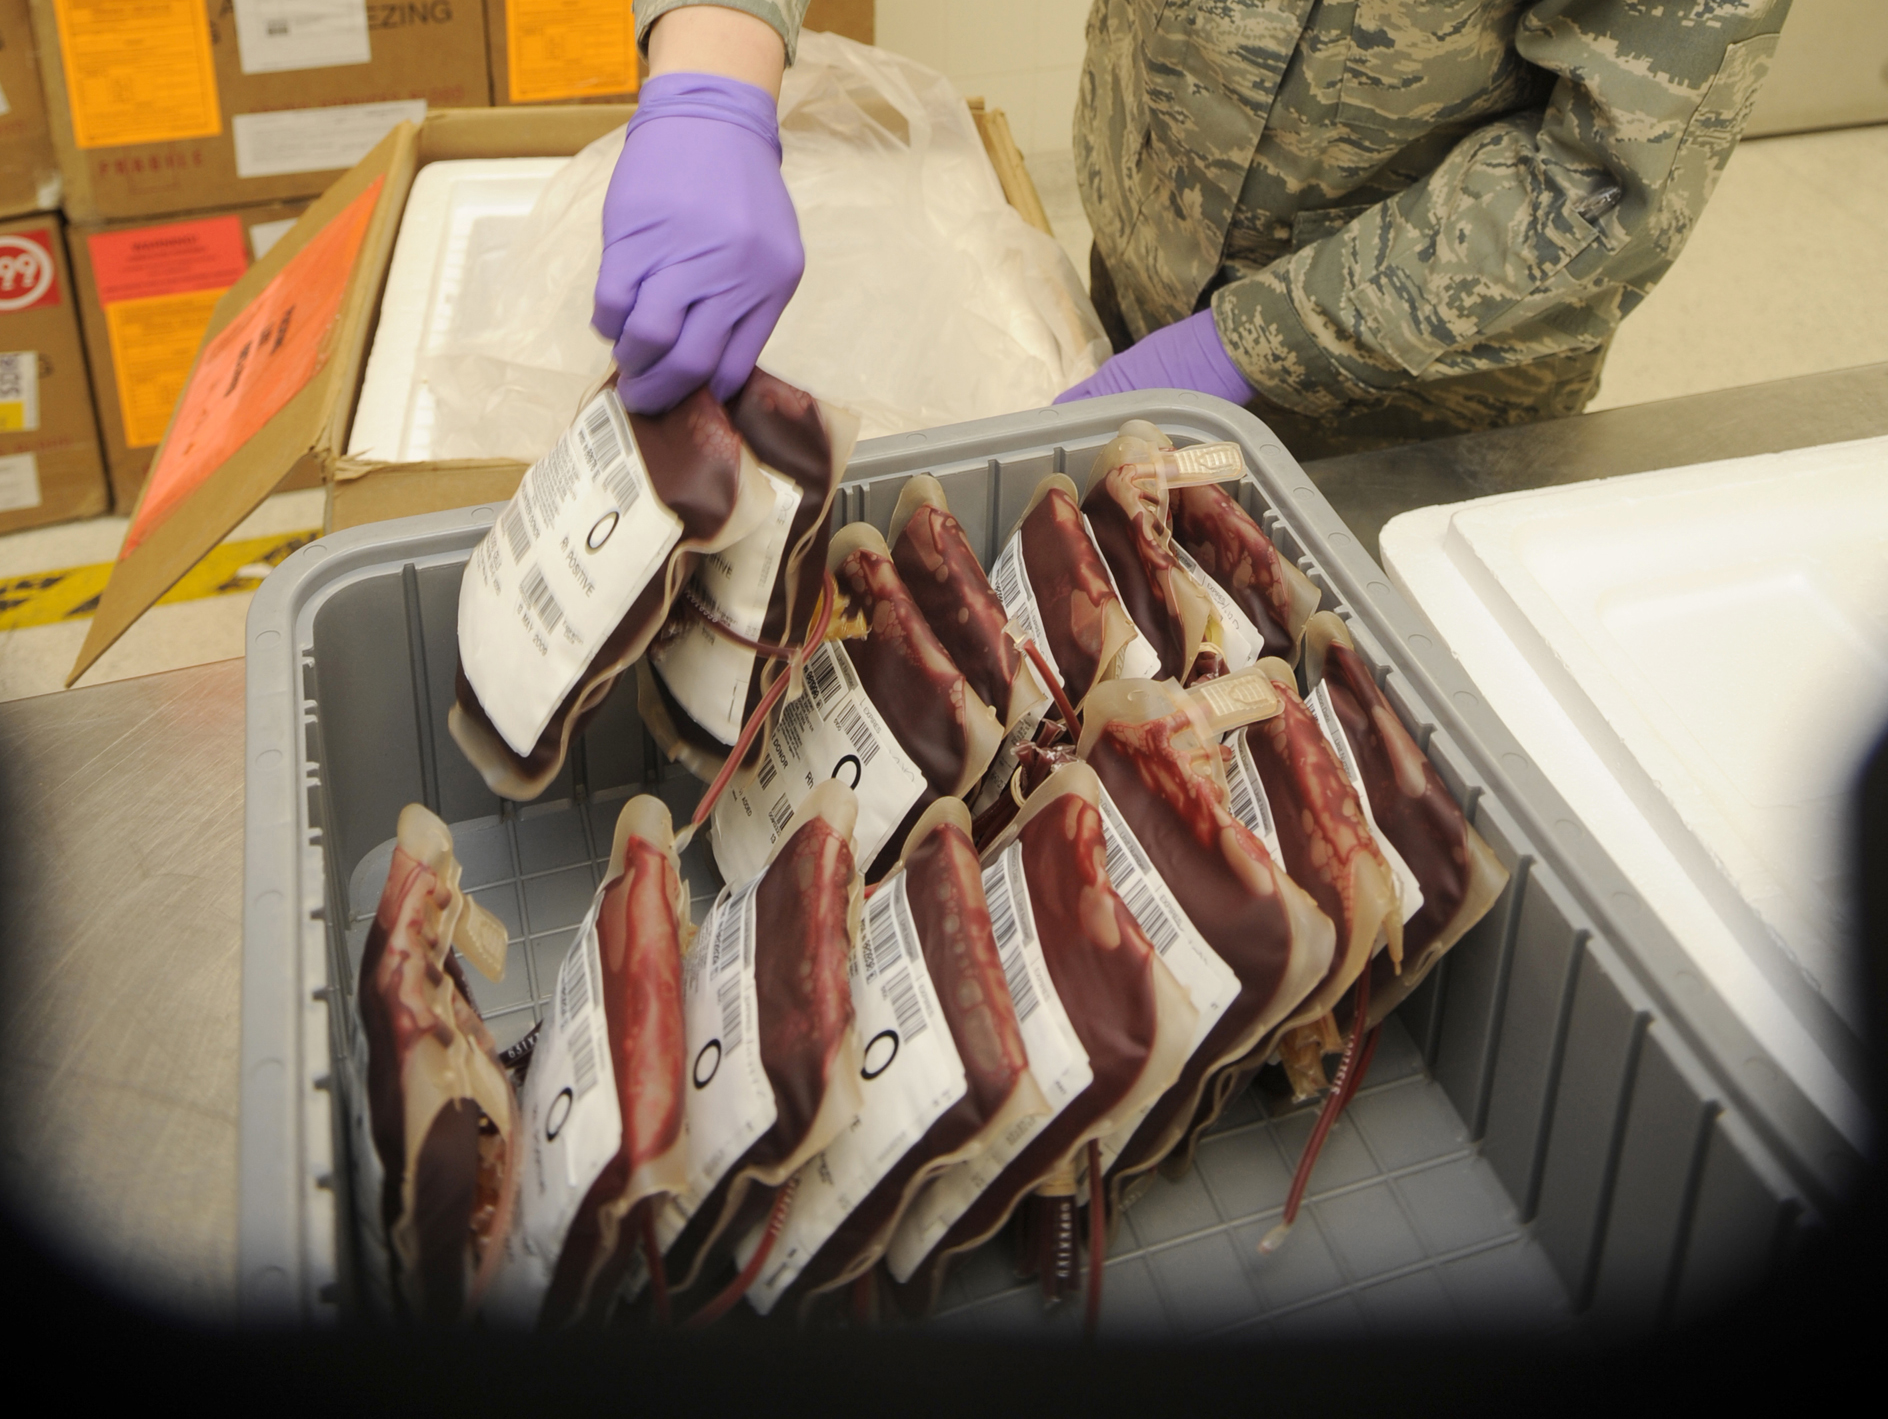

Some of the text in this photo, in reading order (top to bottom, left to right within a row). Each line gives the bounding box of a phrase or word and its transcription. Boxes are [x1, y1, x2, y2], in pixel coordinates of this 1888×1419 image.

[0, 252, 38, 292] 99
[566, 550, 596, 598] POSITIVE
[521, 613, 534, 633] MAY
[863, 706, 882, 734] EXPIRES
[772, 737, 789, 770] DONOR
[804, 771, 815, 790] Rh
[1119, 832, 1146, 872] Unit Number
[1159, 894, 1183, 926] EXPIRES
[693, 1038, 722, 1090] O
[860, 1029, 899, 1081] O
[546, 1086, 574, 1143] O
